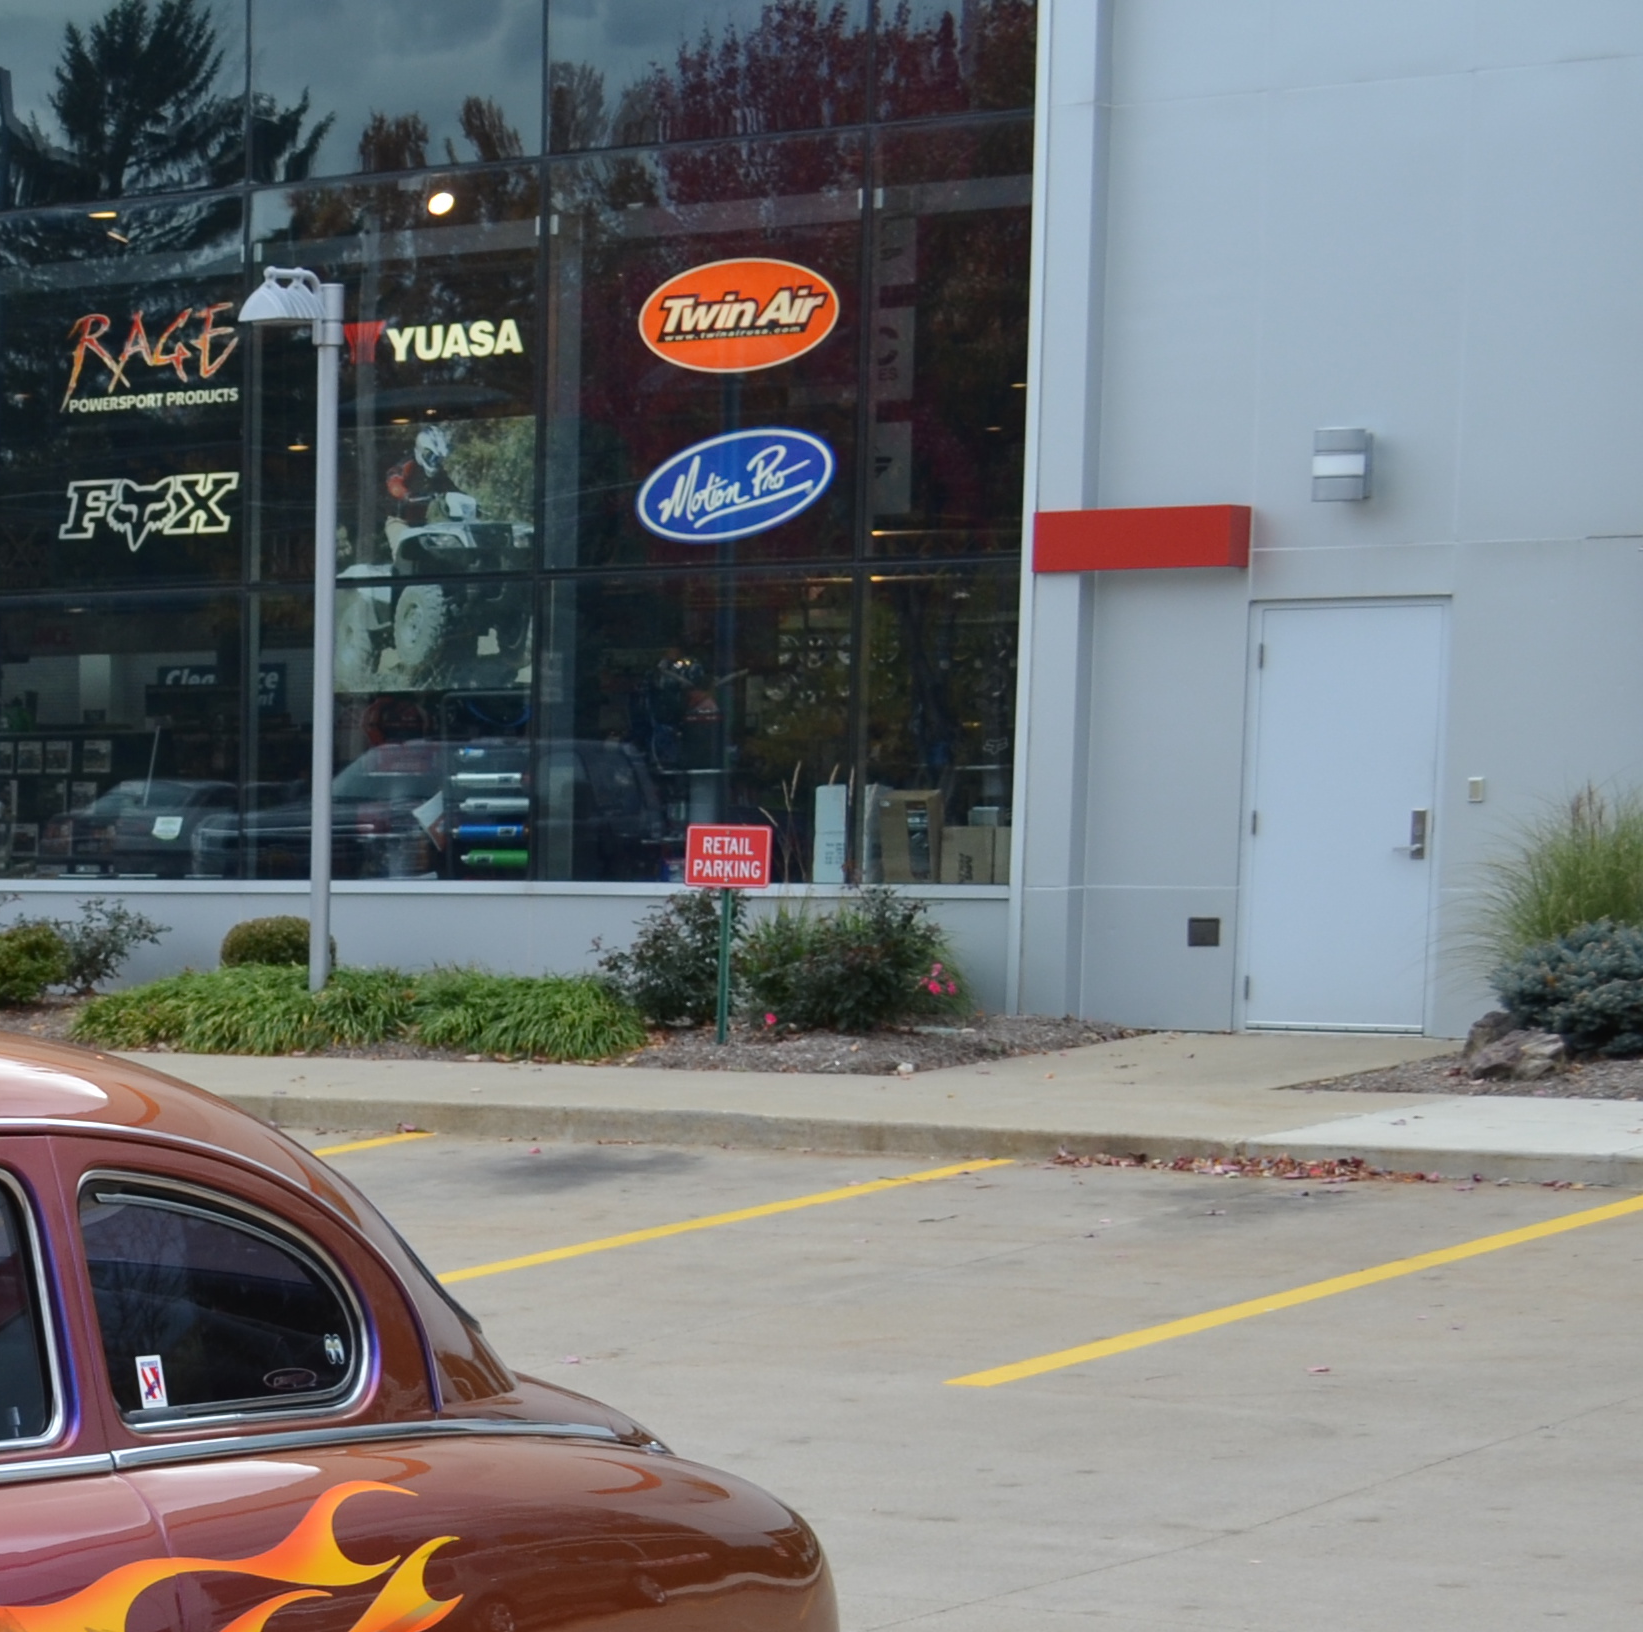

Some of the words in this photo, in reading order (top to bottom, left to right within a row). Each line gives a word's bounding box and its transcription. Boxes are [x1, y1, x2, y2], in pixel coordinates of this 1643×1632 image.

[660, 290, 758, 334] Twin
[755, 284, 828, 328] Air
[60, 302, 239, 413] RAGE
[386, 318, 524, 362] YUASA
[68, 393, 164, 413] POWERSPORT
[166, 387, 239, 406] PRODUCTS
[658, 455, 750, 524] Motion
[746, 444, 811, 497] Pro
[702, 836, 754, 856] RETAIL
[693, 859, 762, 879] PARKING
